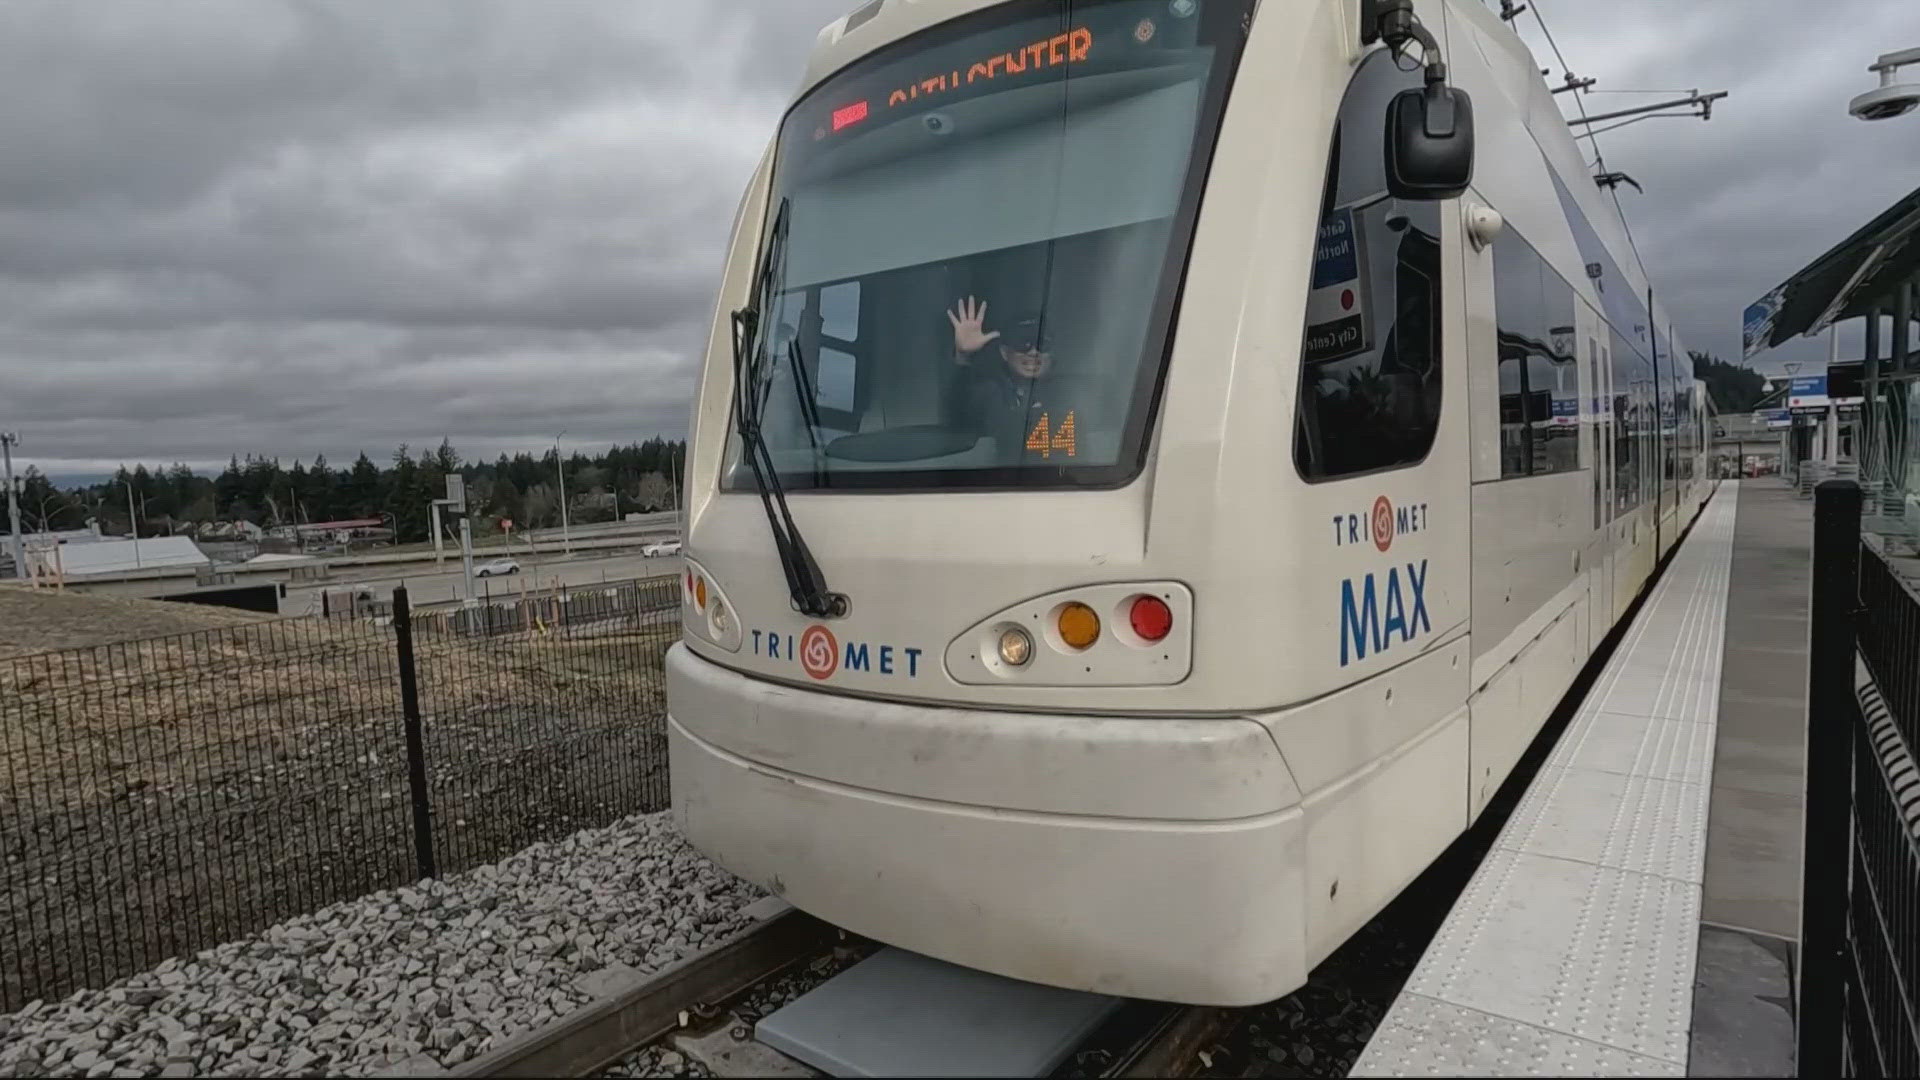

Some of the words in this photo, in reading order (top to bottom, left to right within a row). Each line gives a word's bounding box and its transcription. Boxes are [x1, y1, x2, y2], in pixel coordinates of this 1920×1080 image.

[1026, 410, 1076, 459] 44
[1333, 512, 1368, 546] TRI
[1397, 503, 1428, 535] MET
[1340, 558, 1431, 667] MAX
[752, 629, 793, 661] TRI
[845, 641, 922, 678] MET
